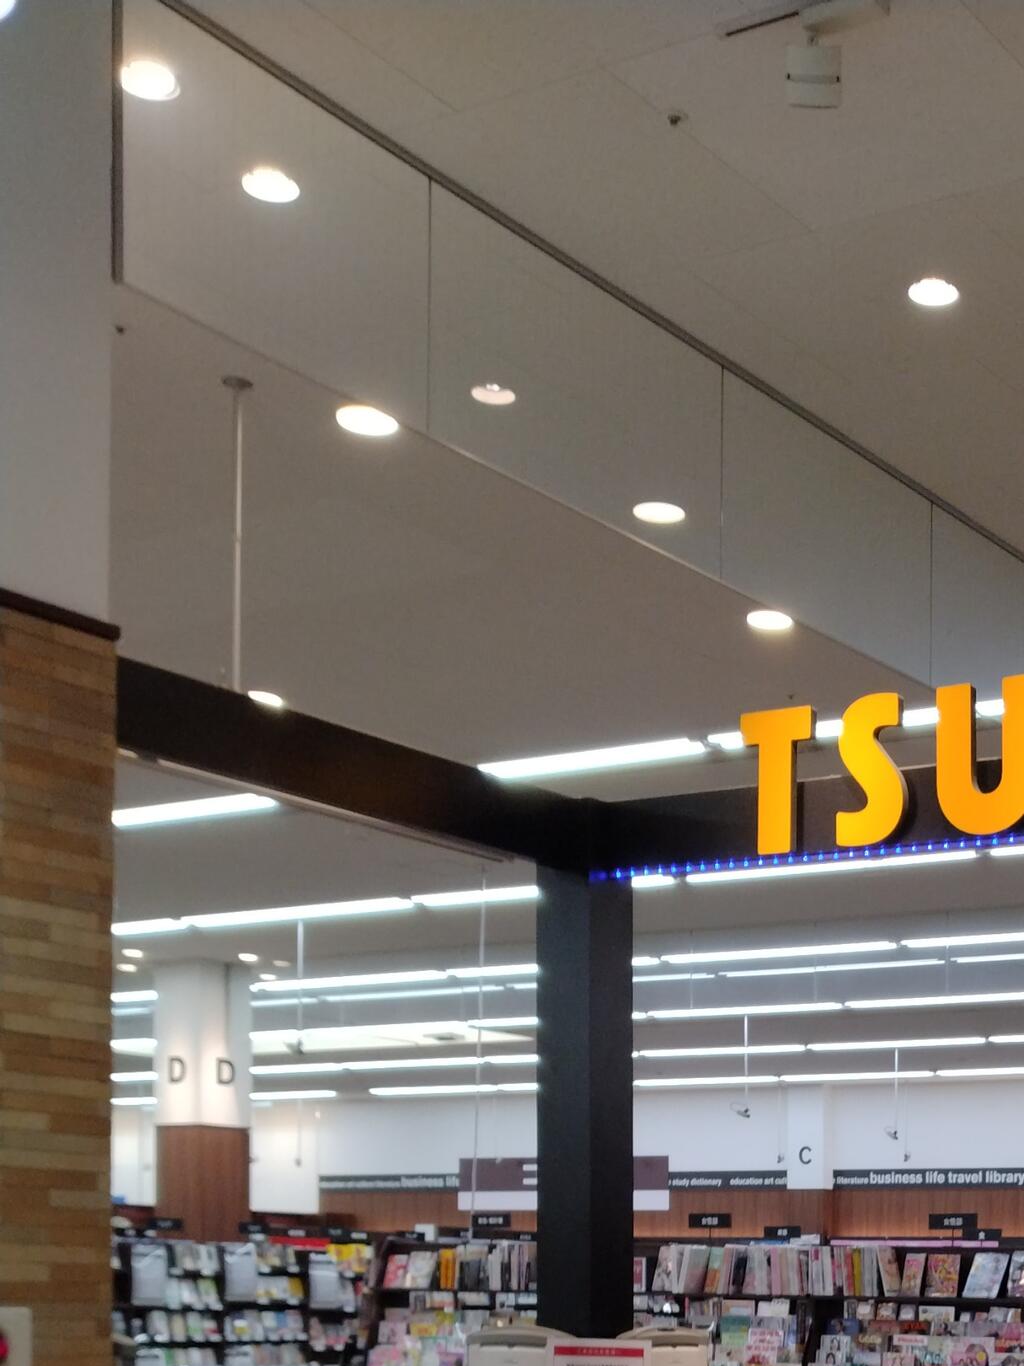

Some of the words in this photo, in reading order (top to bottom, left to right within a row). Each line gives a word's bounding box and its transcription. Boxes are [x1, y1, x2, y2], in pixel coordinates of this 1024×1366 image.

[168, 1057, 186, 1083] D
[216, 1059, 236, 1085] D
[798, 1145, 812, 1166] C
[869, 1171, 922, 1185] business
[925, 1170, 945, 1184] life
[947, 1169, 983, 1184] travel
